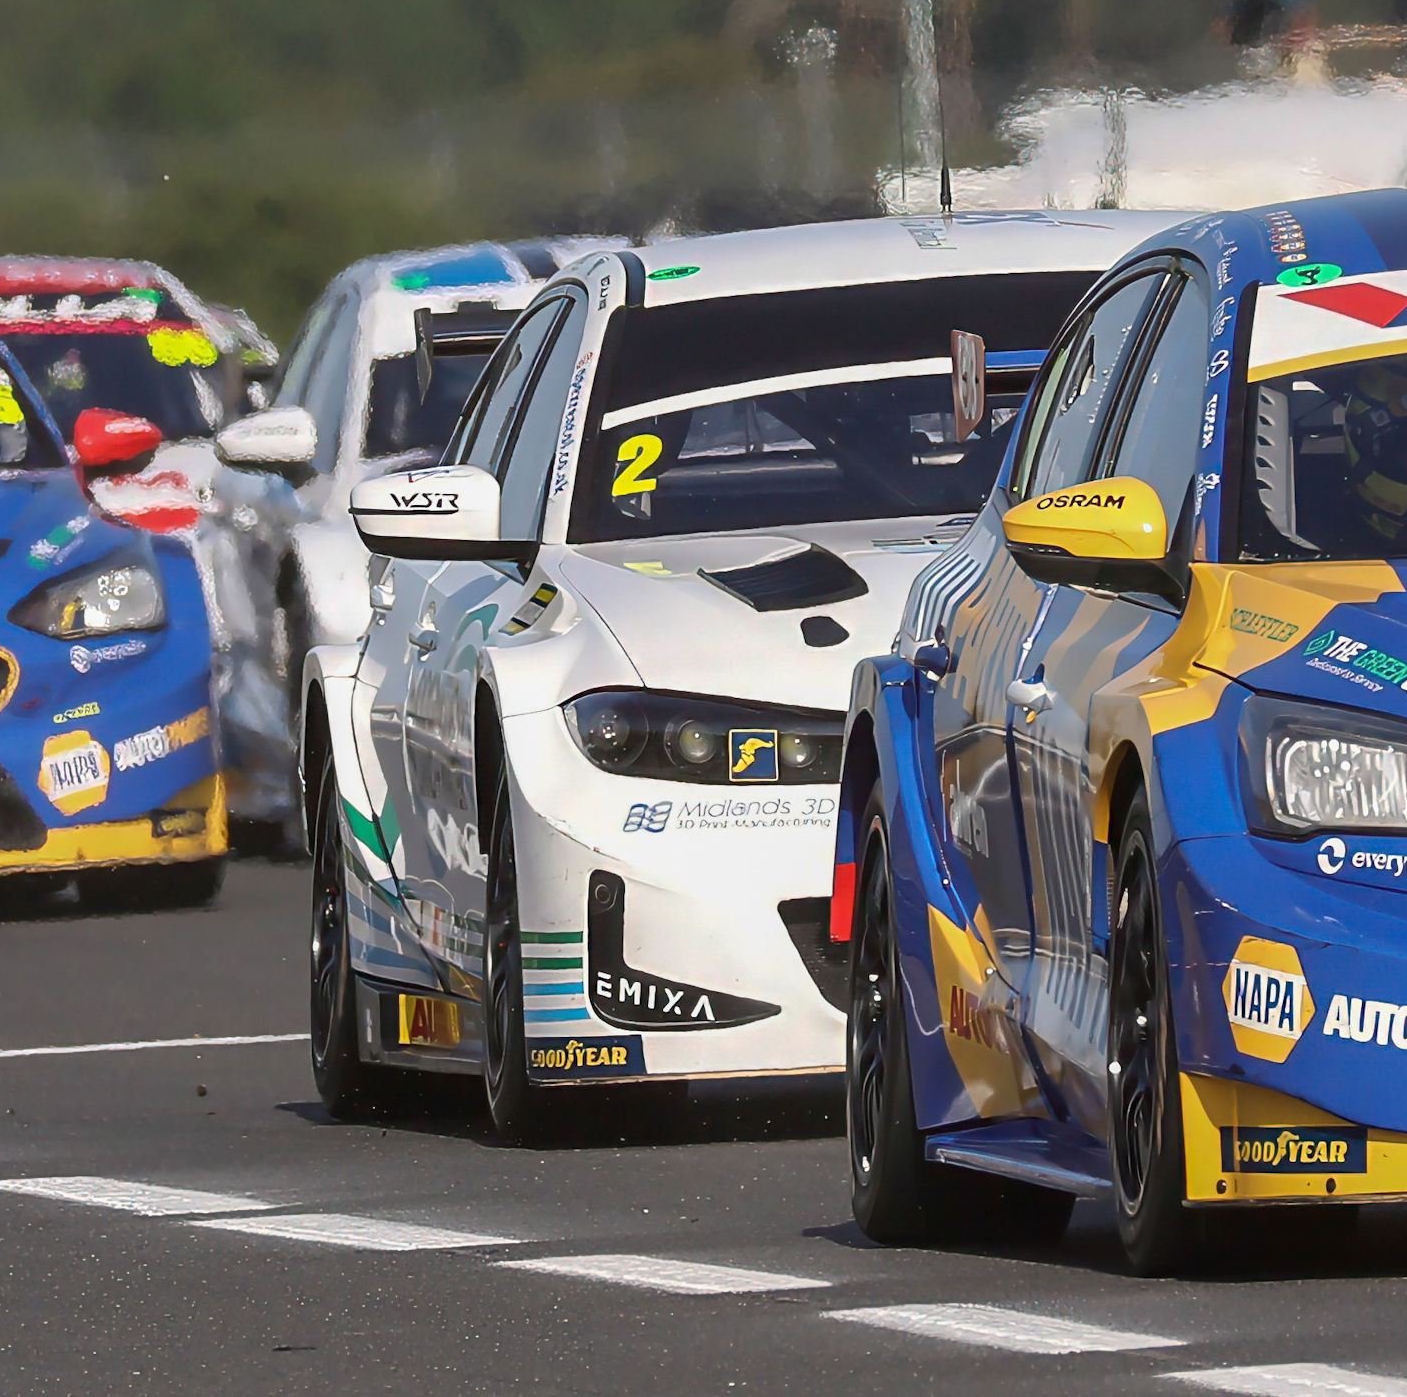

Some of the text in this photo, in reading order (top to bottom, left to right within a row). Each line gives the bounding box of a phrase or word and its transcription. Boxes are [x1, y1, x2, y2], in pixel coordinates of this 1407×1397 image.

[611, 434, 663, 498] 2
[390, 492, 460, 508] WSR
[1036, 494, 1127, 510] OSRAM
[1322, 635, 1369, 664] THE
[677, 798, 836, 818] Midlands 3D
[596, 970, 717, 1022] EMIXA
[1233, 968, 1295, 1032] NAPA
[530, 1040, 629, 1071] GOODYEAR
